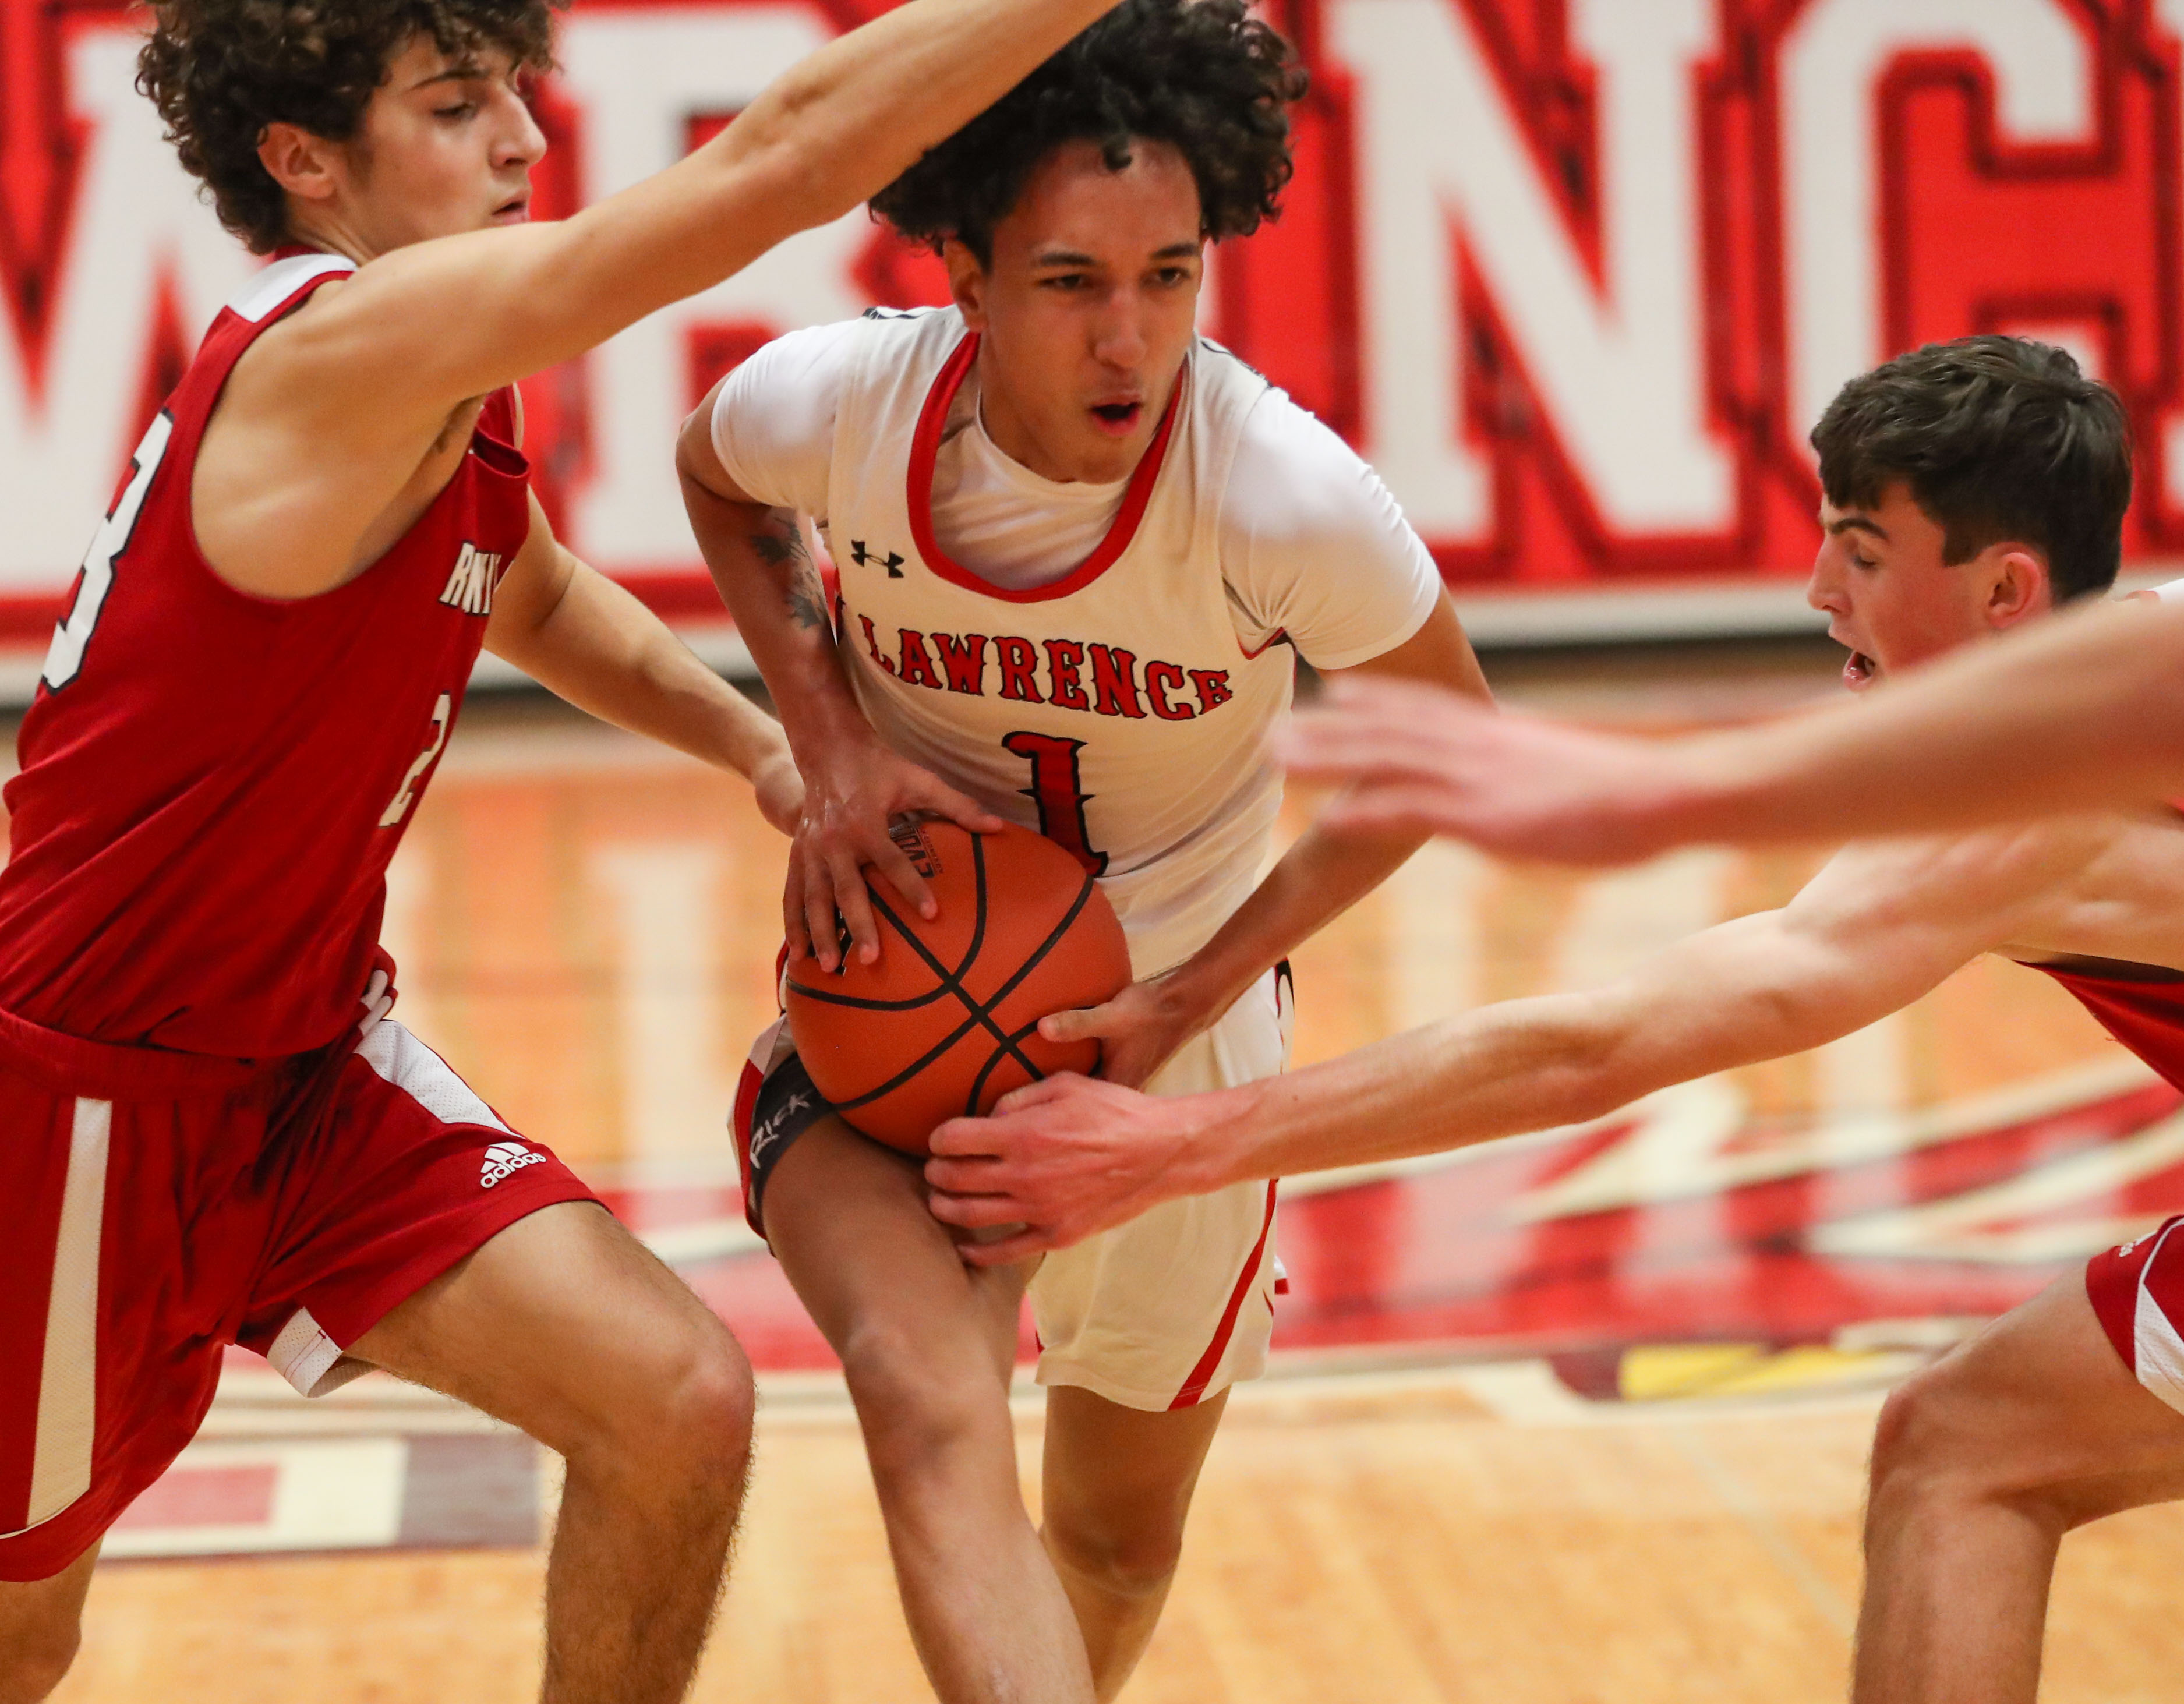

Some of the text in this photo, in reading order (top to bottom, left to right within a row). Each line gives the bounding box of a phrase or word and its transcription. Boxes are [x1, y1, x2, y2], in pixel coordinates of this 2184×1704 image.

[858, 613, 1234, 721] LAWRENCE
[378, 690, 451, 829] 2
[1001, 731, 1109, 878] 1
[480, 1153, 547, 1189] adidas
